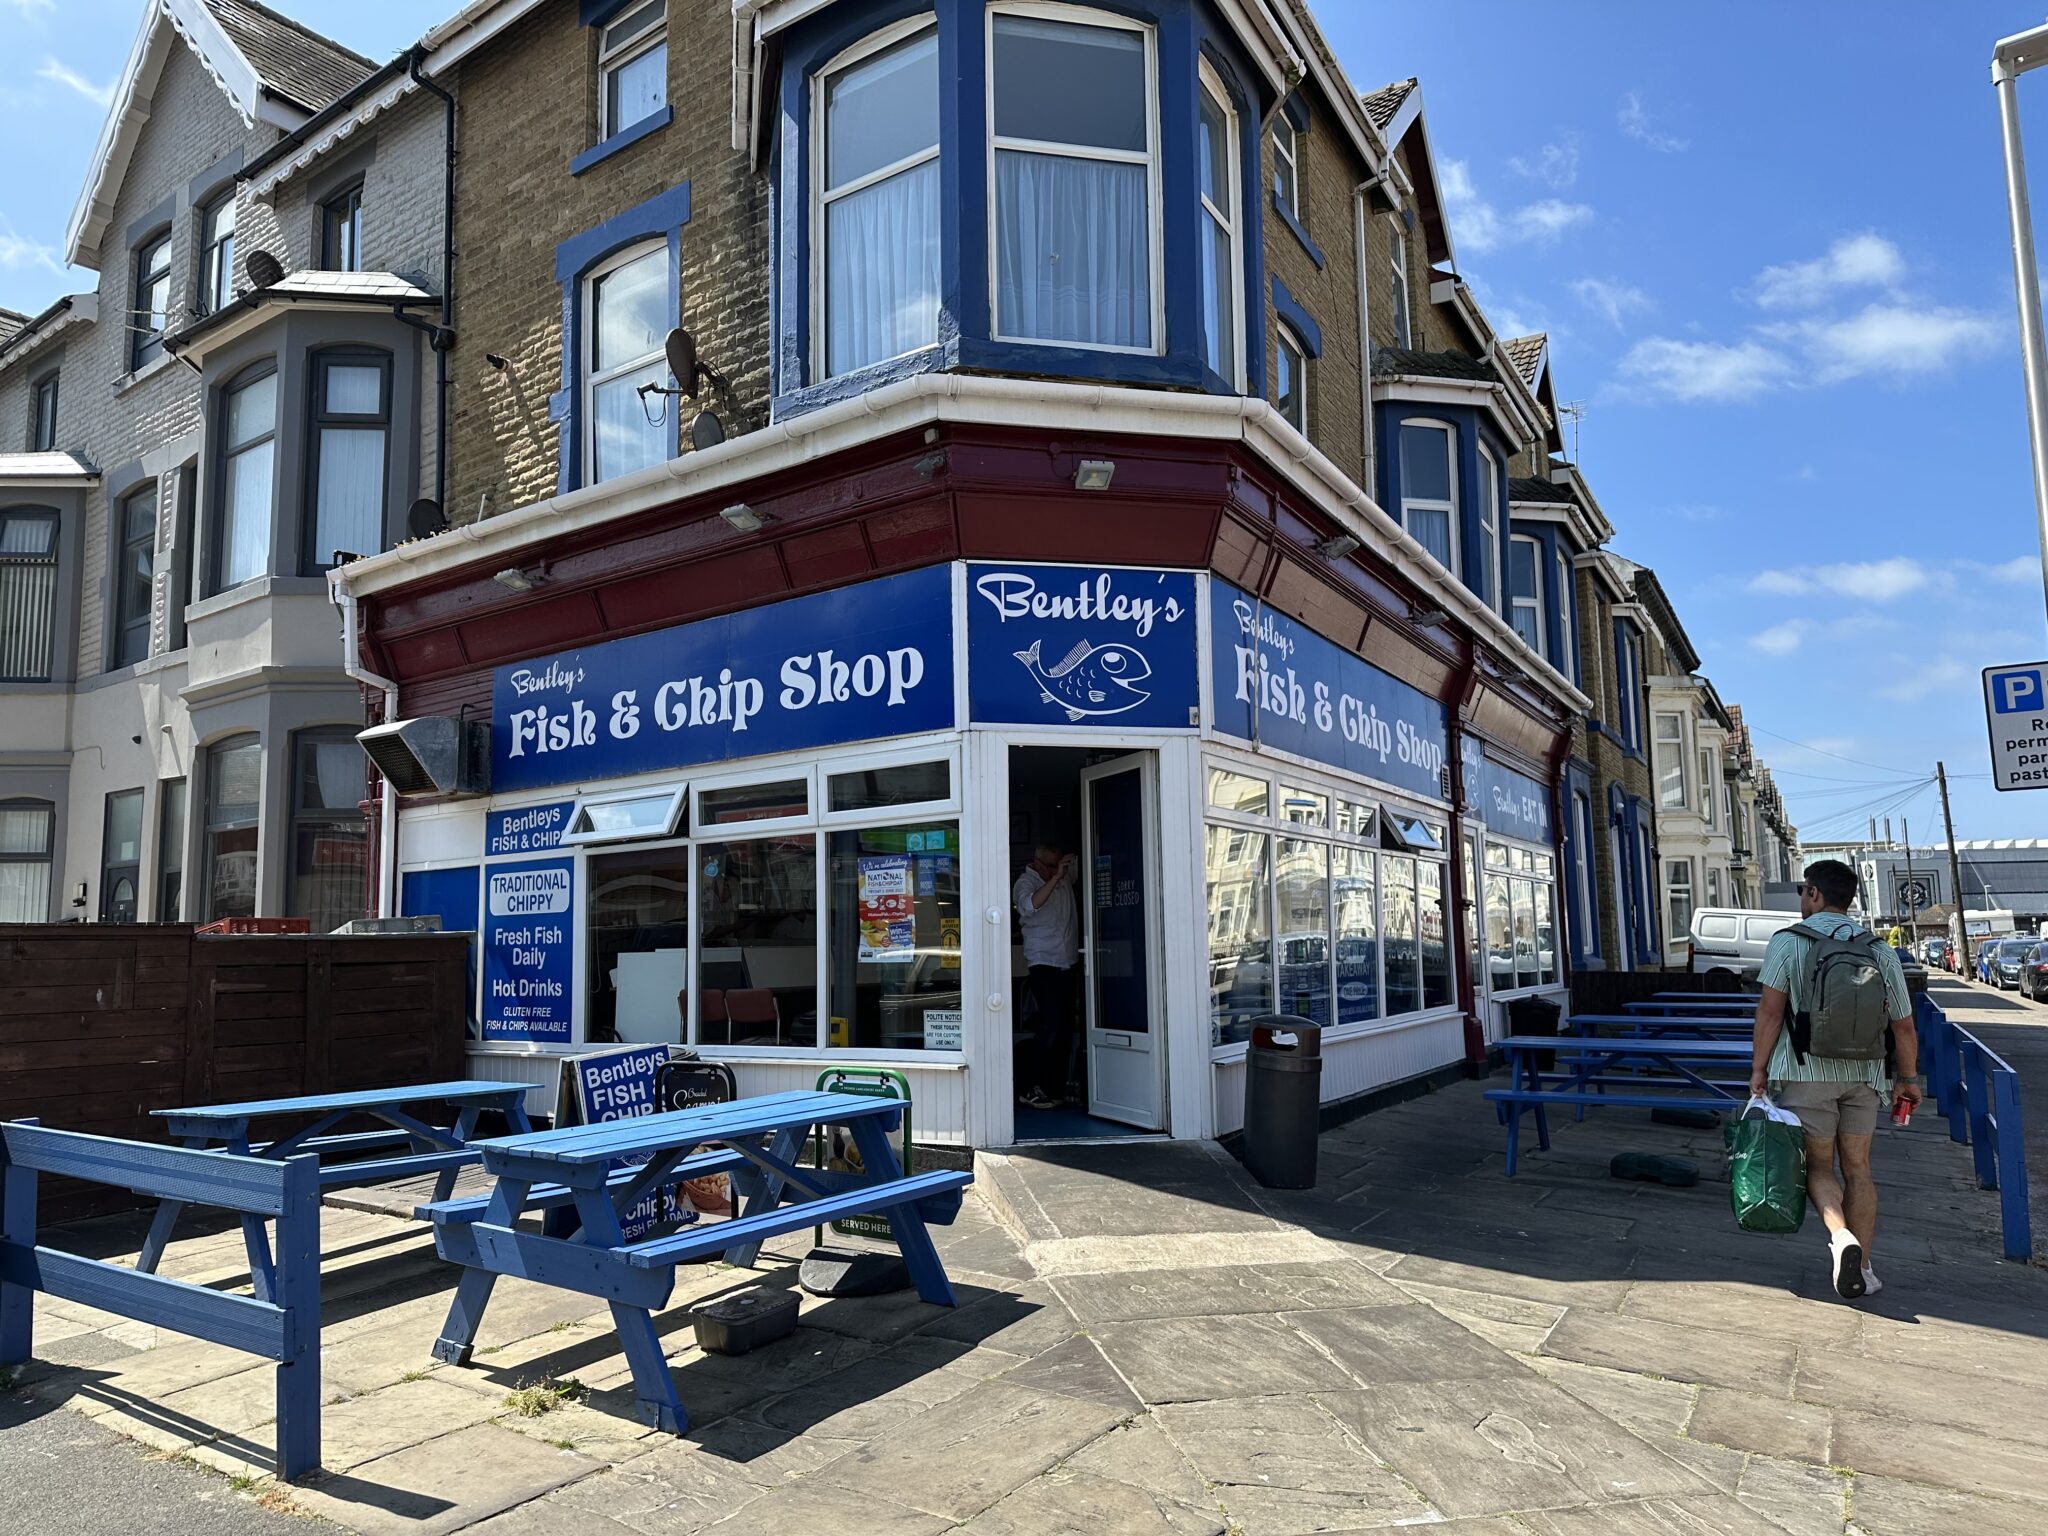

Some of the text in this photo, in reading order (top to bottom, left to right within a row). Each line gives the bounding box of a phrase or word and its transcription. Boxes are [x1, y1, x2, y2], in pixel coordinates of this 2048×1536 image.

[976, 573, 1185, 637] Bentley's
[1233, 600, 1295, 661] Bentley's
[511, 654, 586, 698] Bentley's
[509, 647, 924, 758] Fish & Chip Shop
[2004, 675, 2035, 709] P
[1234, 644, 1442, 782] Fish & Chip Shop
[2031, 718, 2048, 731] R
[503, 807, 561, 835] Bentleys
[1522, 796, 1537, 824] EAT
[1538, 802, 1547, 828] IN
[492, 830, 563, 852] FISH & CHIP
[493, 872, 567, 893] TRADITIONAL
[507, 893, 553, 912] CHIPPY
[495, 926, 562, 945] Fresh Fish
[512, 947, 546, 970] Daily
[493, 978, 562, 997] Hot Drinks
[503, 1006, 551, 1018] GLUTEN FREE
[926, 1013, 944, 1021] POLITE
[486, 1020, 568, 1032] FISH & CHIPS AVAILABLE
[586, 1052, 666, 1088] Bentleys
[592, 1081, 646, 1111] FISH
[841, 1218, 891, 1234] SERVED HERE
